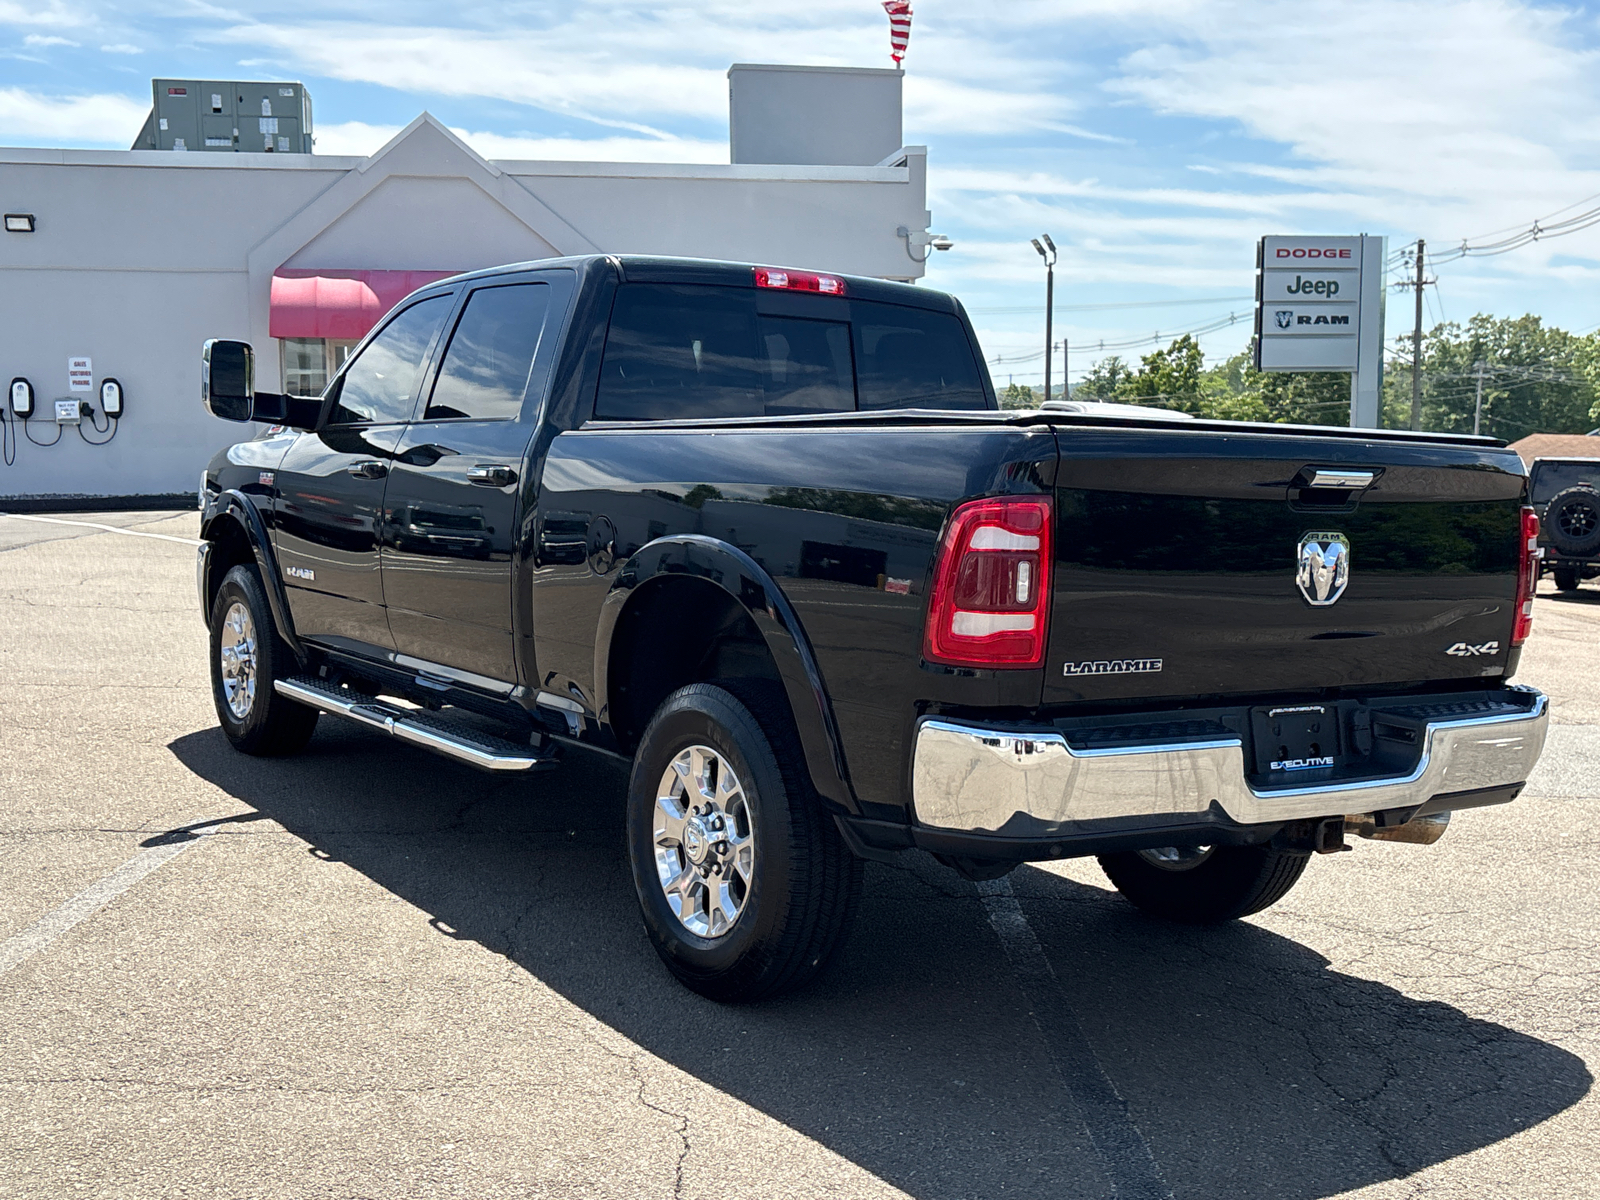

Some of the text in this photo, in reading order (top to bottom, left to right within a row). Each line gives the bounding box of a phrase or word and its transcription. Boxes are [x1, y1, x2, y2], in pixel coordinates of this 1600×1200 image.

[1276, 249, 1351, 258] DODGE
[1287, 275, 1339, 298] Jeep
[1297, 315, 1349, 325] RAM
[1444, 641, 1500, 657] 4x4
[1063, 658, 1163, 676] LARAMIE
[1270, 756, 1334, 771] EXECUTIVE
